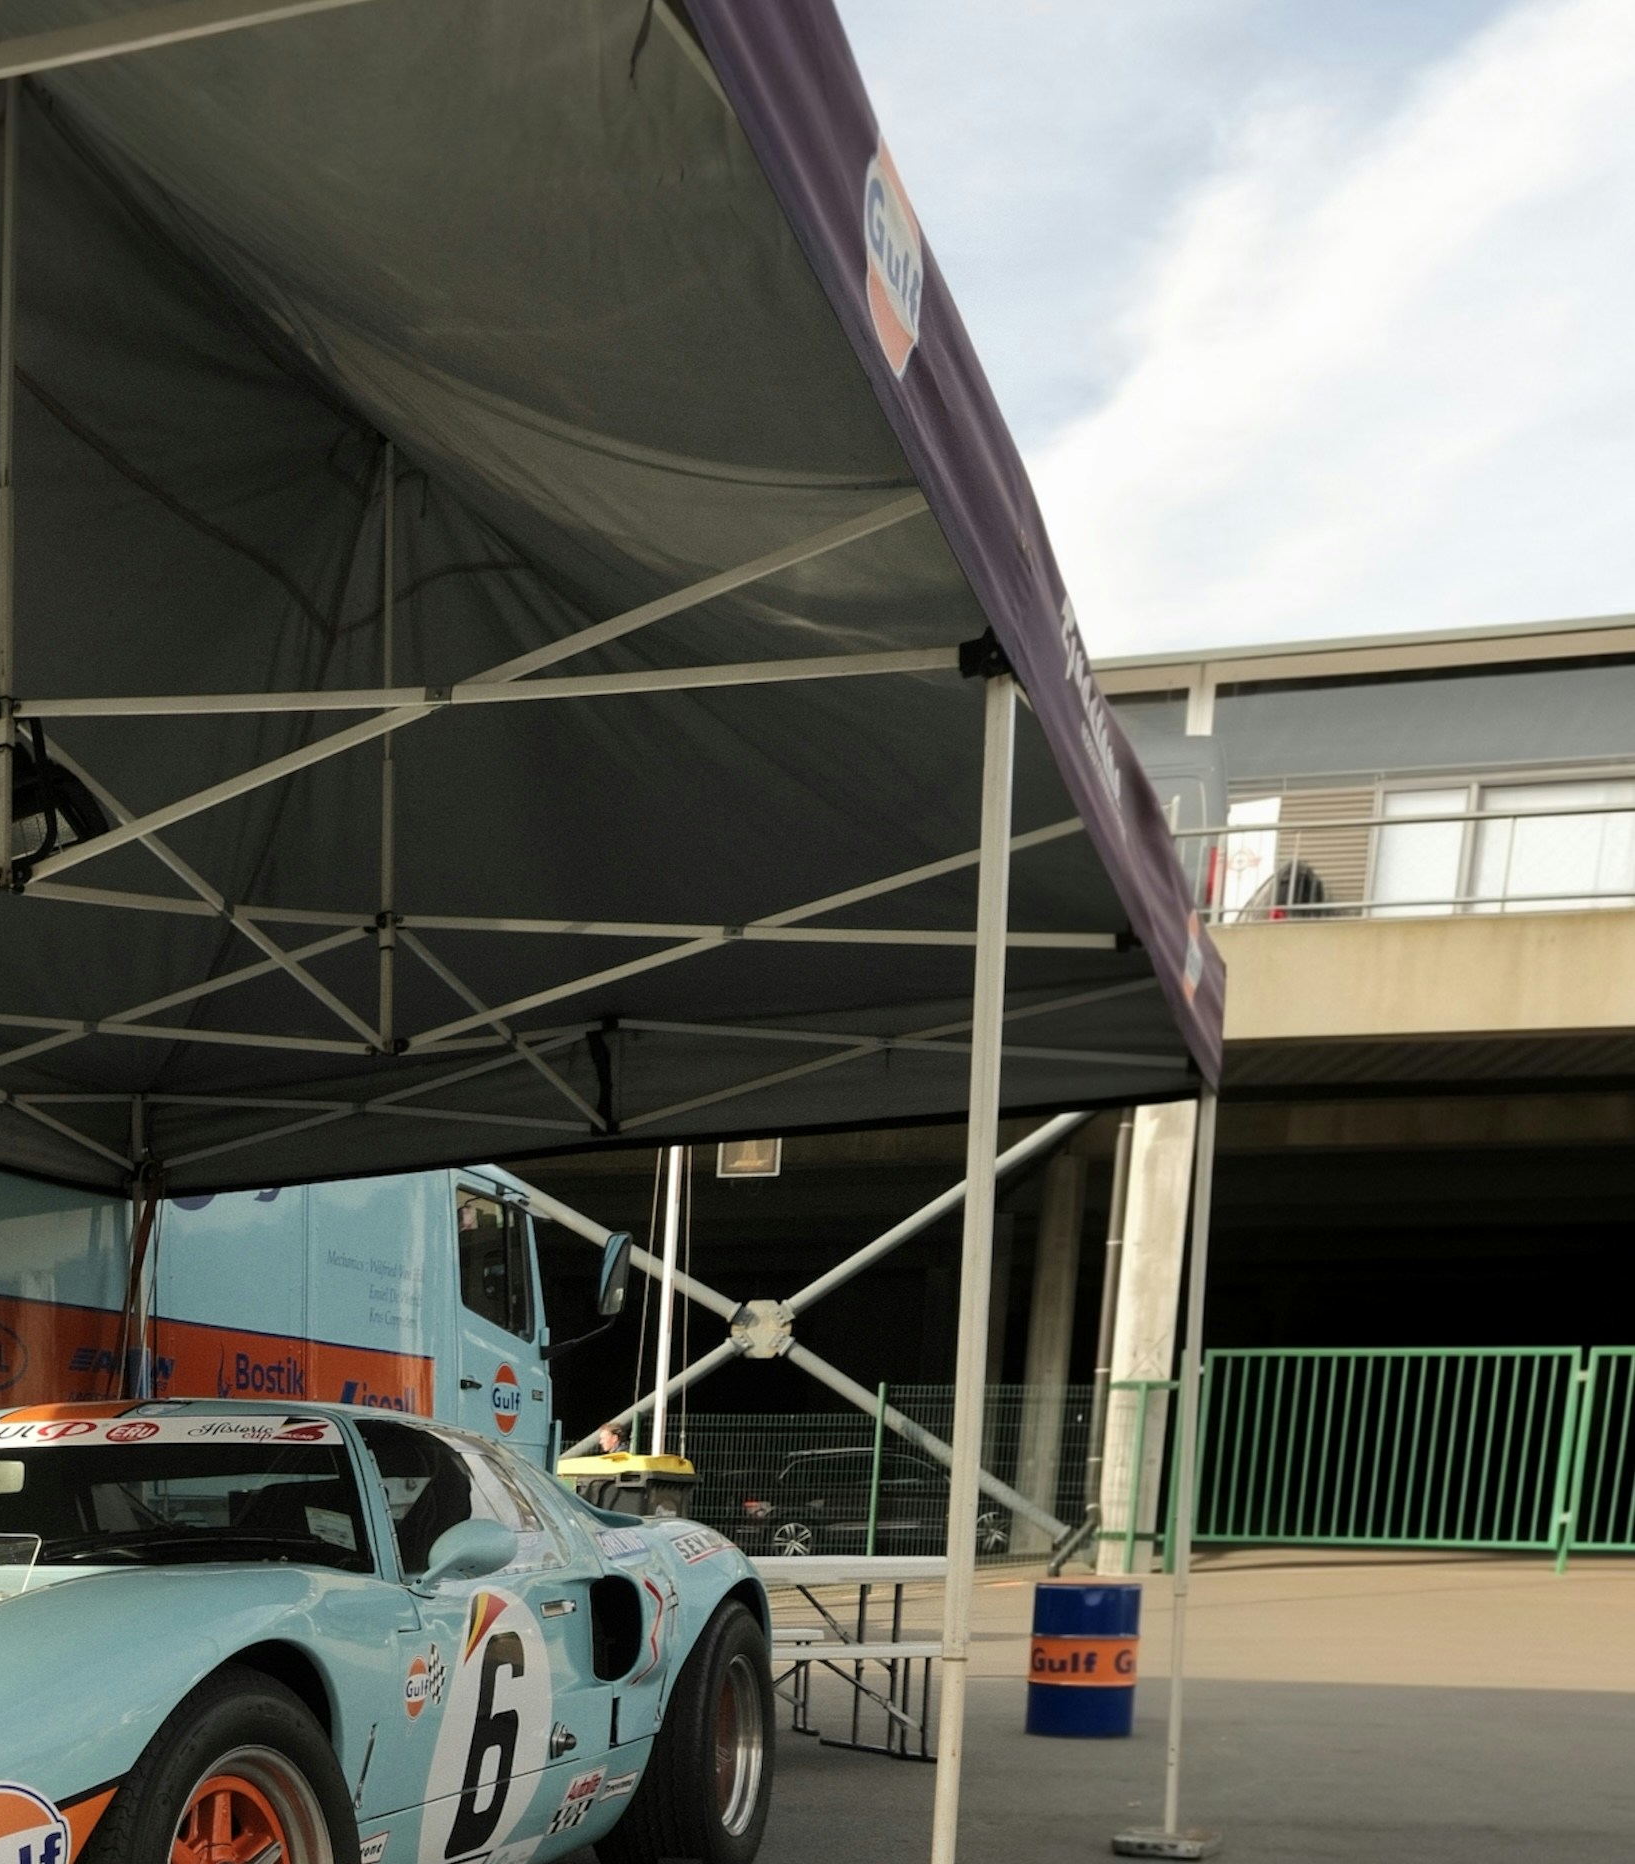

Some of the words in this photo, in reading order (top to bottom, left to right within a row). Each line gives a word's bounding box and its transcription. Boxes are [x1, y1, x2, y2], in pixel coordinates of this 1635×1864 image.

[867, 177, 920, 328] Gulf
[235, 1352, 305, 1396] Bostik
[492, 1387, 521, 1411] Gulf
[1031, 1647, 1099, 1675] Gulf
[1114, 1649, 1137, 1675] G
[405, 1679, 430, 1699] Gulf
[444, 1630, 525, 1861] 6
